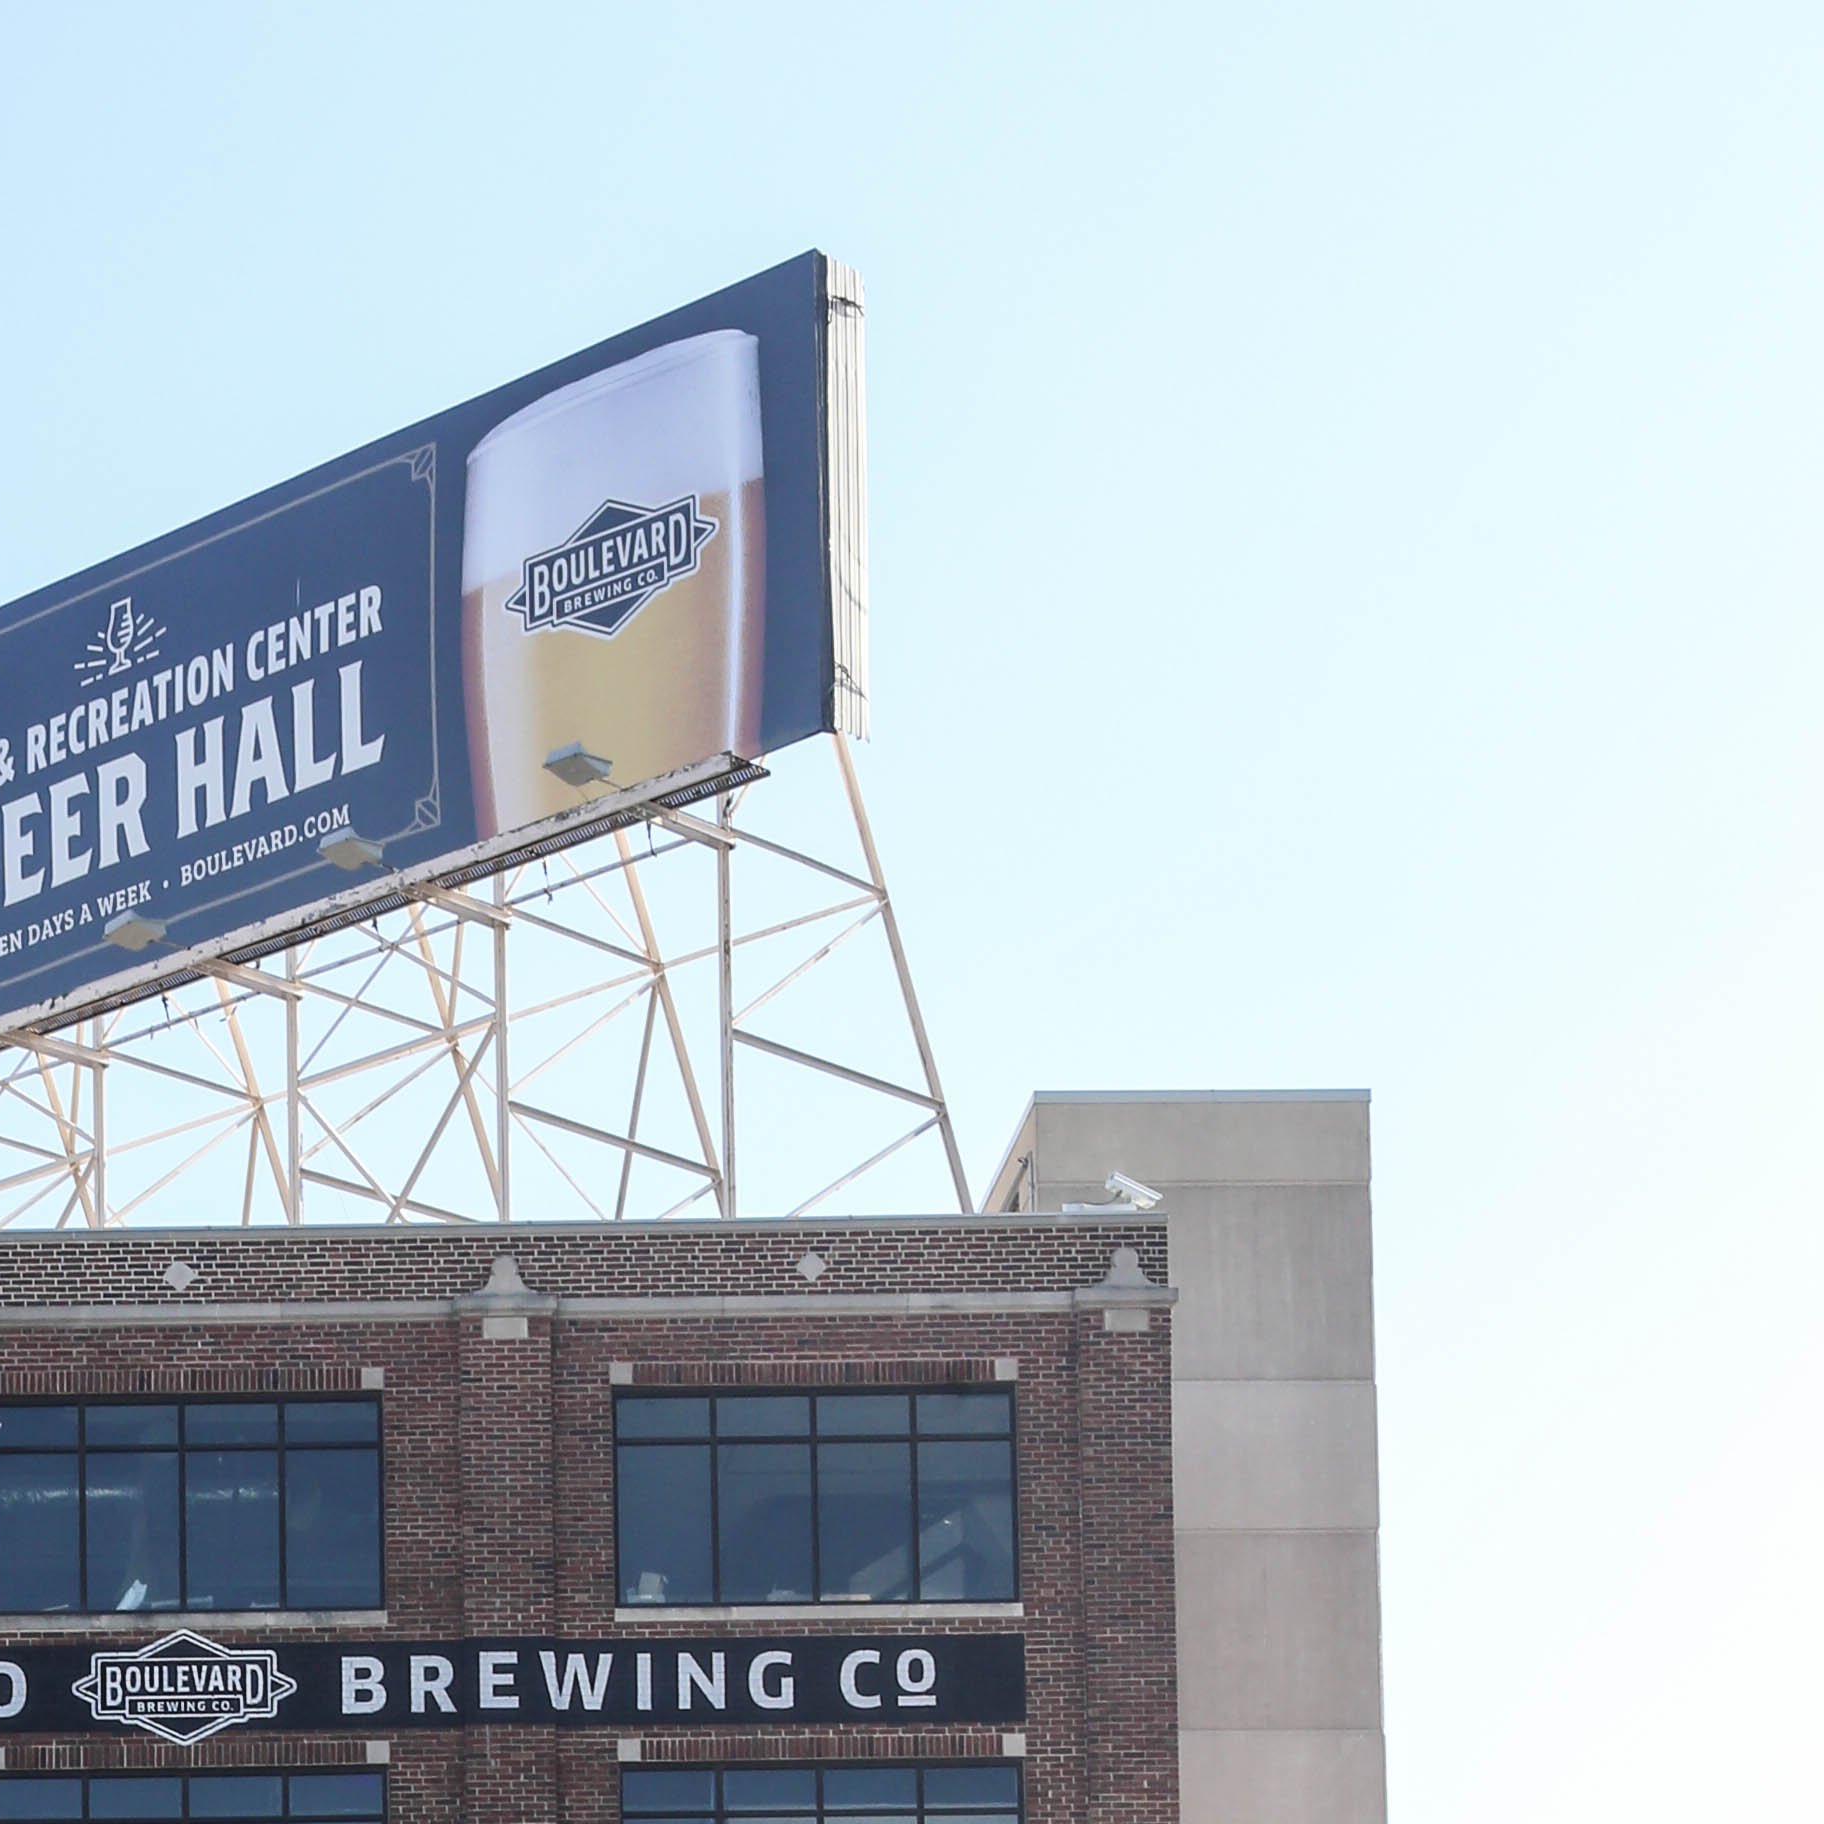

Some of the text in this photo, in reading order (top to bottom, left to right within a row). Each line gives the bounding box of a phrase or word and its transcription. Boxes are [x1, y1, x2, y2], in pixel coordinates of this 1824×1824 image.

[532, 513, 688, 617] BOULEVARD
[563, 572, 659, 615] BREWING CO.
[26, 643, 234, 775] RECREATION
[246, 584, 383, 682] CENTER
[175, 660, 385, 840] HALL
[179, 803, 351, 888] BOULEVARD.COM
[27, 909, 75, 946] DAYS
[79, 903, 93, 924] A
[96, 879, 152, 917] WEEK
[105, 1663, 264, 1707] BOULEVARD
[137, 1700, 234, 1713] BREWING CO.
[341, 1650, 796, 1714] BREWING
